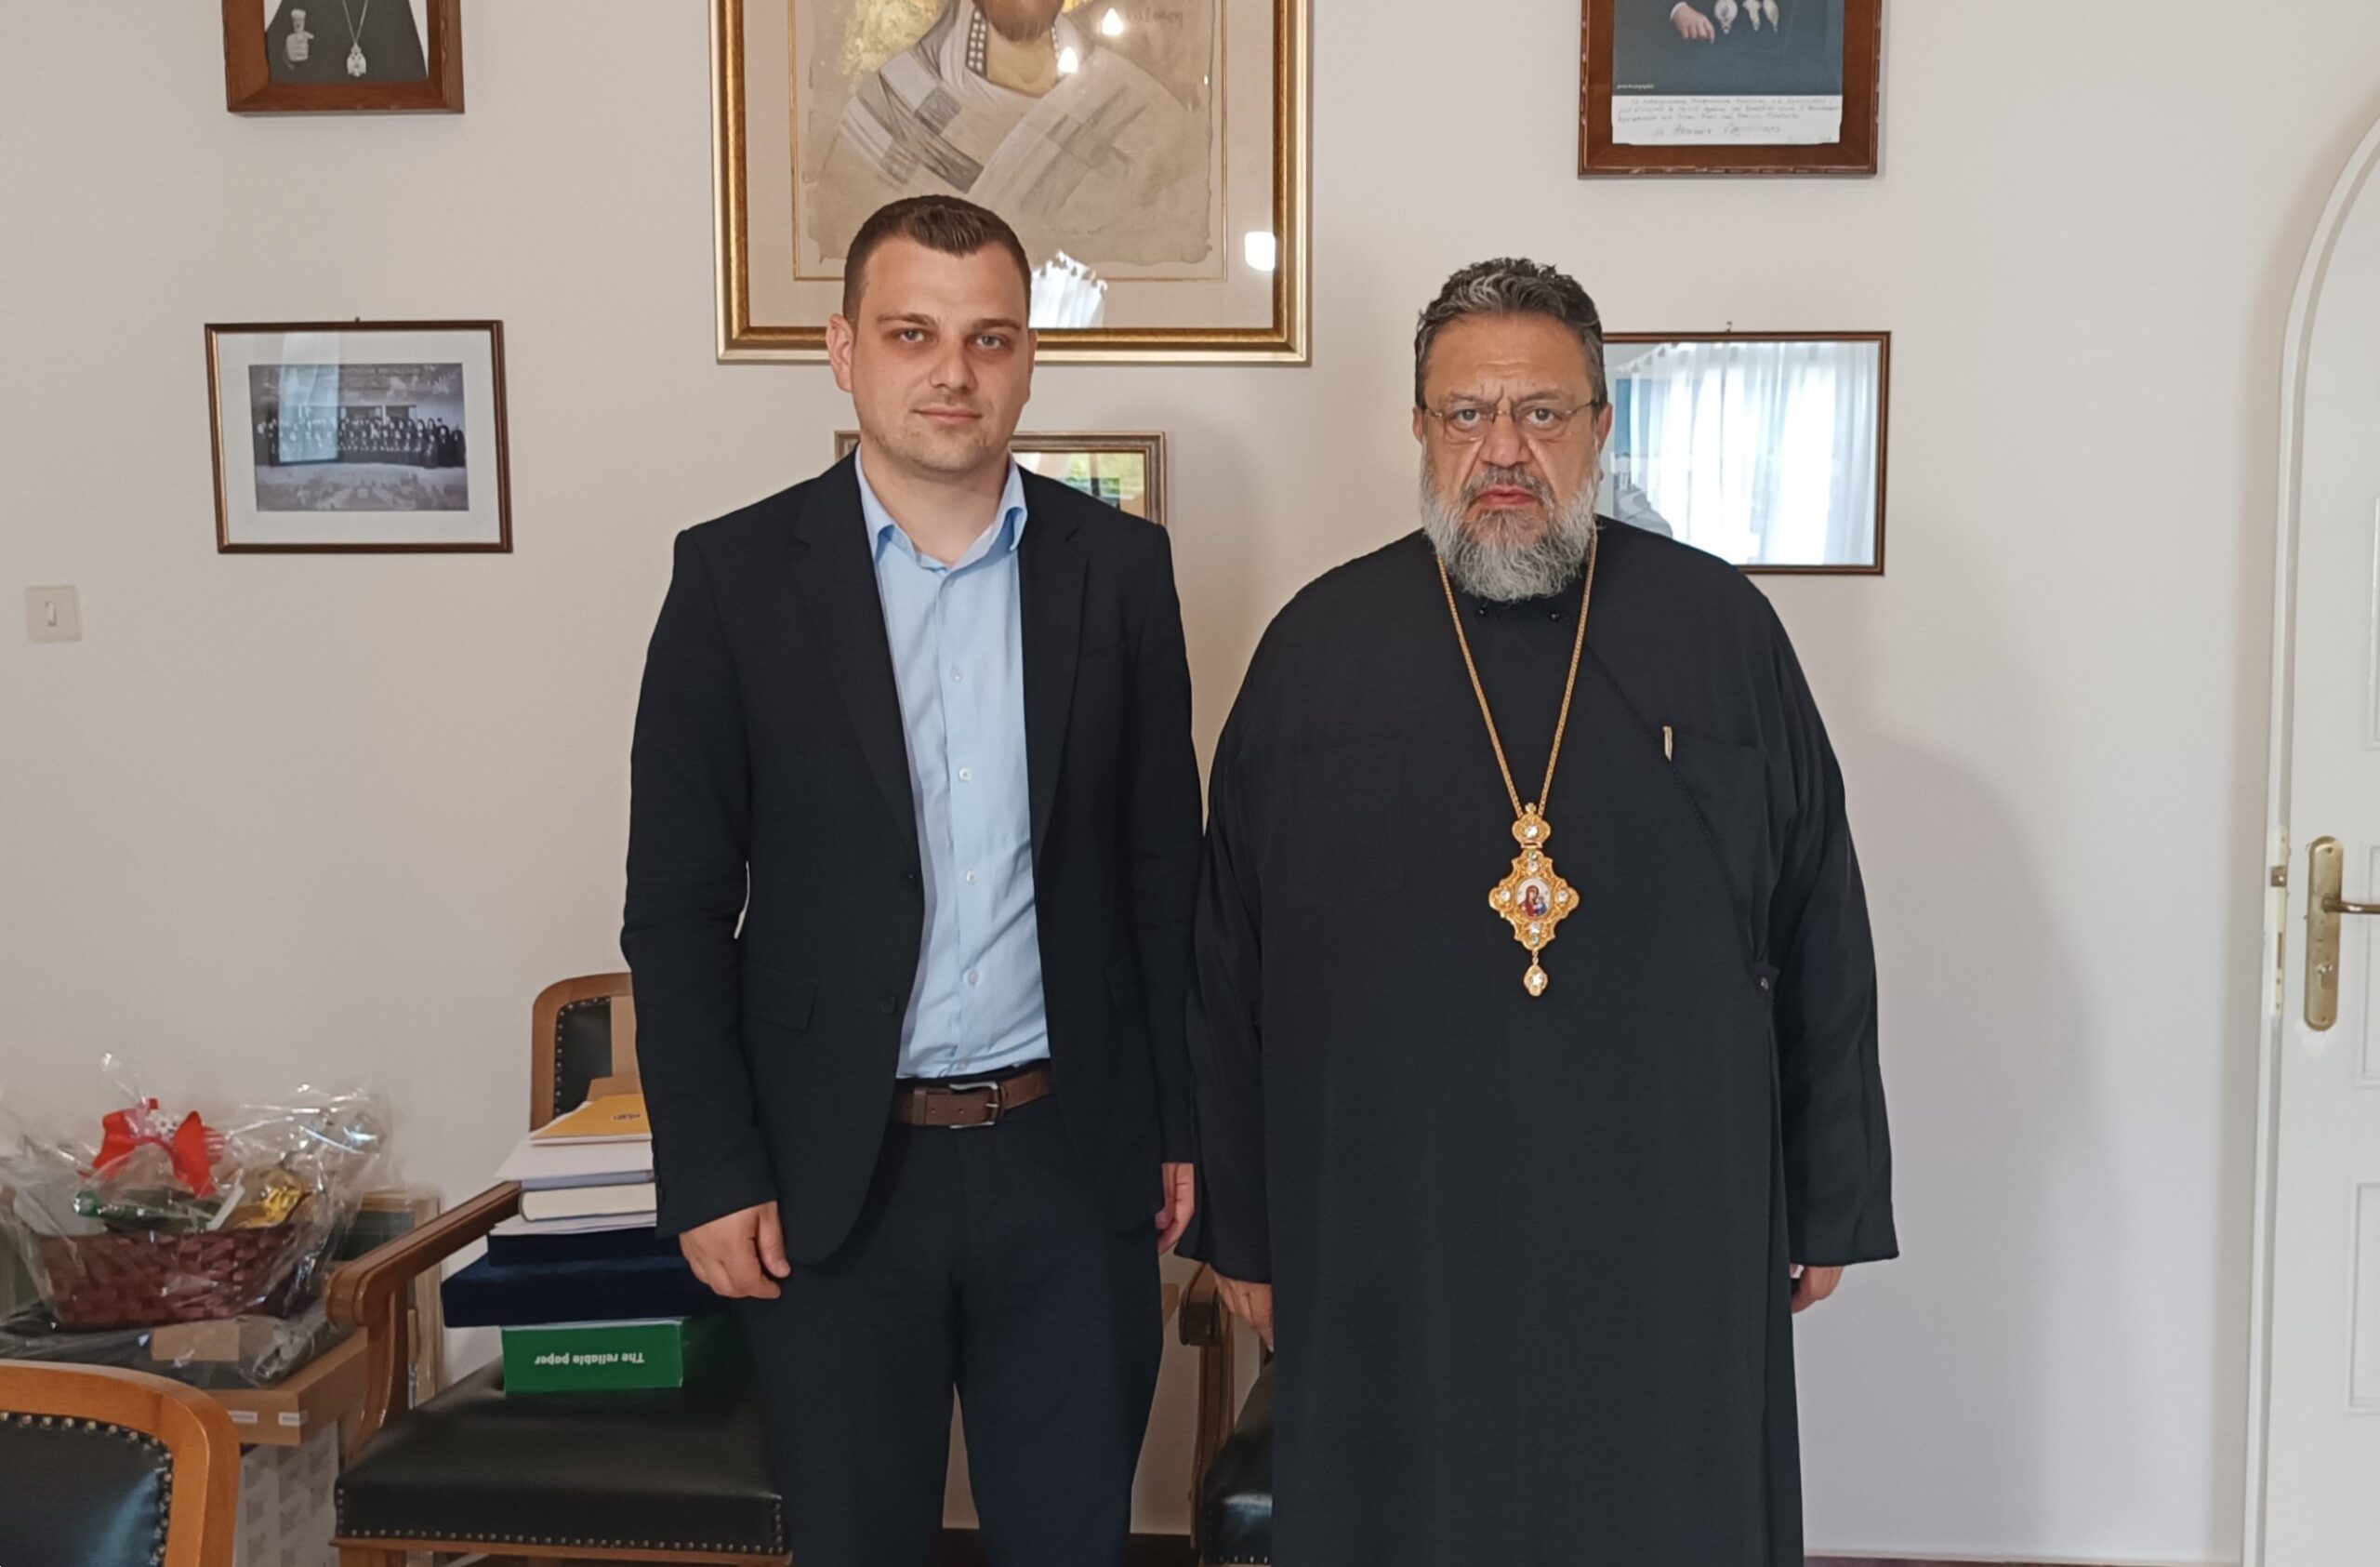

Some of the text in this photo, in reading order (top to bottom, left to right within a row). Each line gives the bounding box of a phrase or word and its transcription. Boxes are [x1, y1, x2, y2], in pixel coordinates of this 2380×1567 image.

[535, 1352, 644, 1364] The reliable paper
